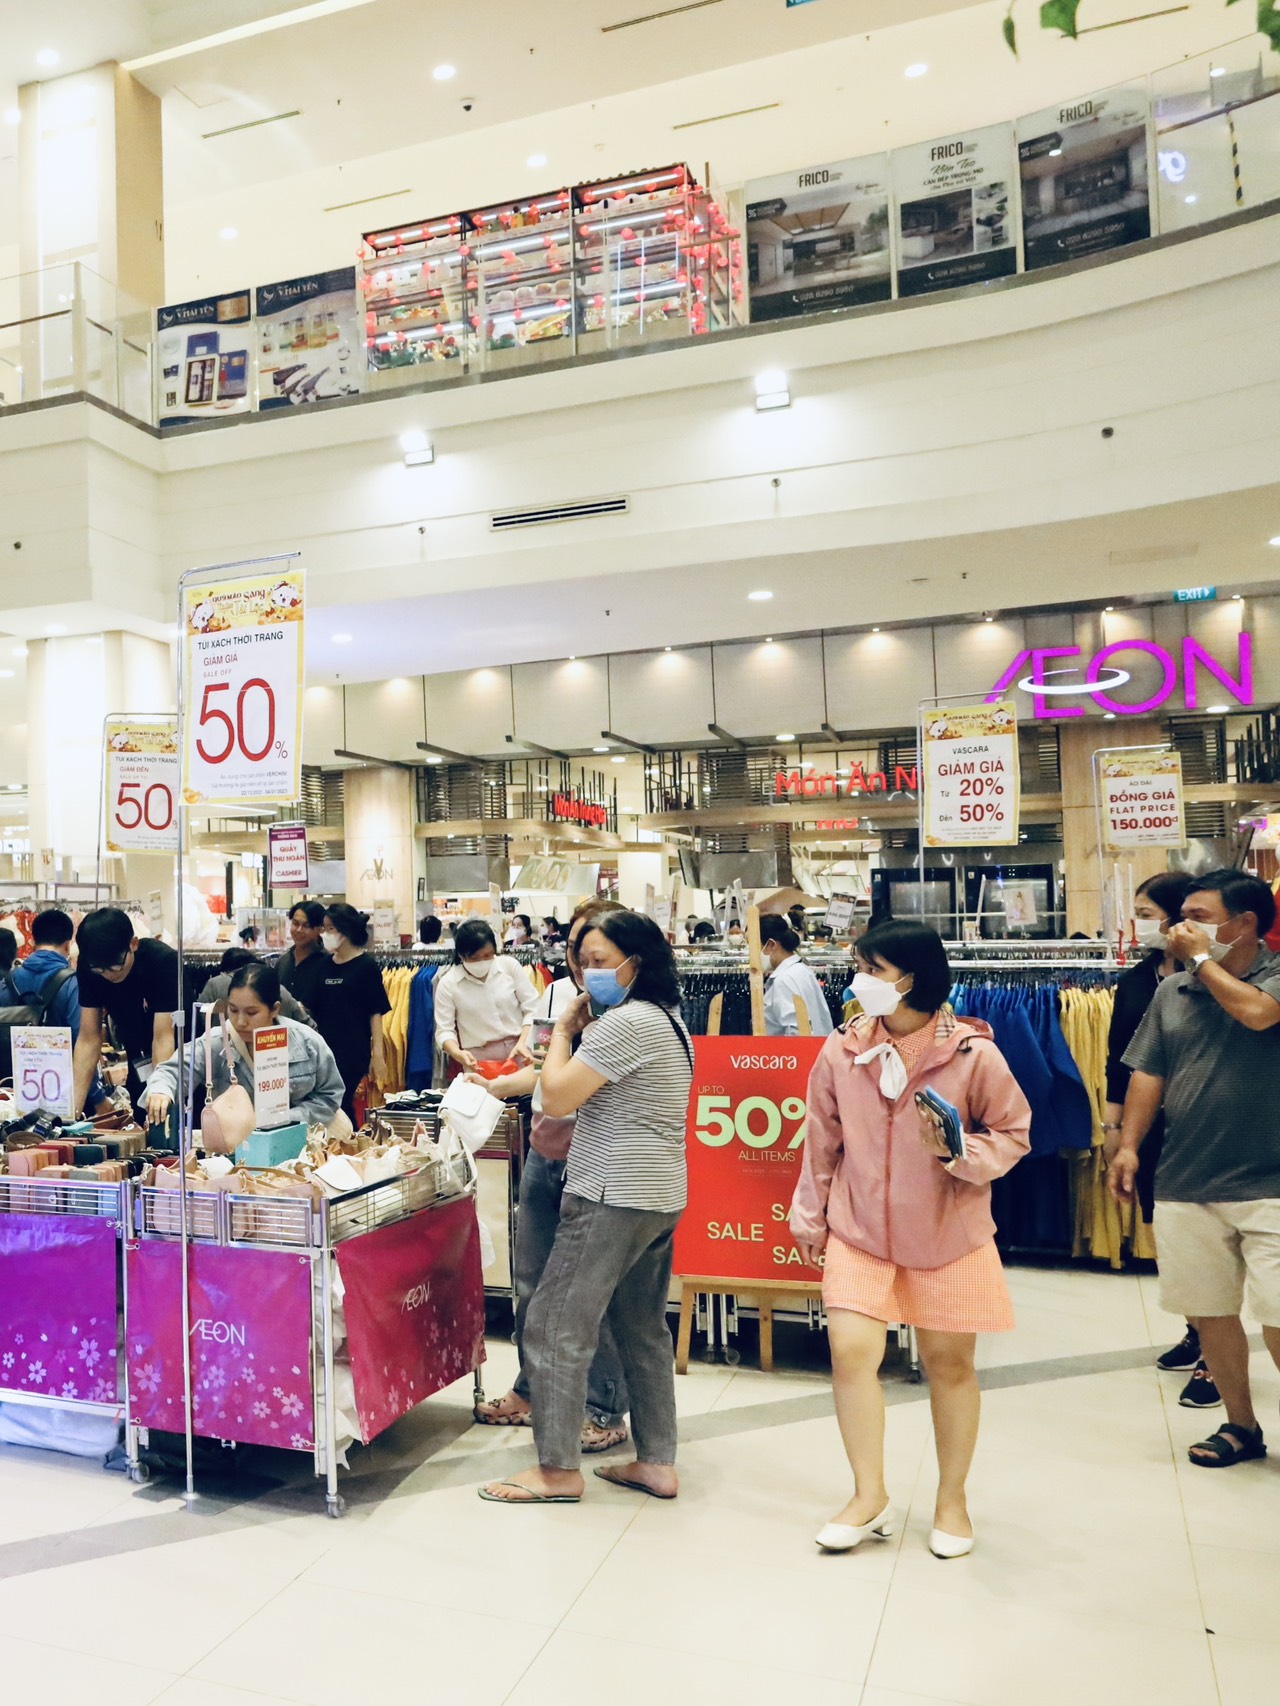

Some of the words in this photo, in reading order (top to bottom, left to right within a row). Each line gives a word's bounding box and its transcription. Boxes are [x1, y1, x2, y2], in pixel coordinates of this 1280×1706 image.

[1059, 100, 1093, 124] FRICO
[931, 141, 963, 161] FRICO
[799, 170, 829, 188] FRICO
[1177, 587, 1204, 600] EXIT
[255, 630, 284, 642] TRANG
[203, 669, 218, 679] SALE
[220, 668, 232, 677] OFF
[952, 745, 989, 754] VASCARA
[938, 759, 975, 776] GIẢM
[980, 756, 1005, 774] GIÁ
[775, 768, 838, 796] Món
[847, 761, 888, 793] Ăn
[959, 777, 1004, 797] 20%
[1152, 788, 1175, 800] GIÁ
[960, 803, 1004, 822] 50%
[1110, 806, 1135, 815] FLAT
[1140, 804, 1176, 813] PRICE
[276, 869, 302, 877] CASHIER
[730, 1054, 798, 1070] vascara
[697, 1085, 709, 1094] UP
[711, 1085, 725, 1094] TO
[738, 1150, 759, 1161] ALL
[761, 1150, 796, 1162] ITEMS
[707, 1221, 765, 1242] SALE
